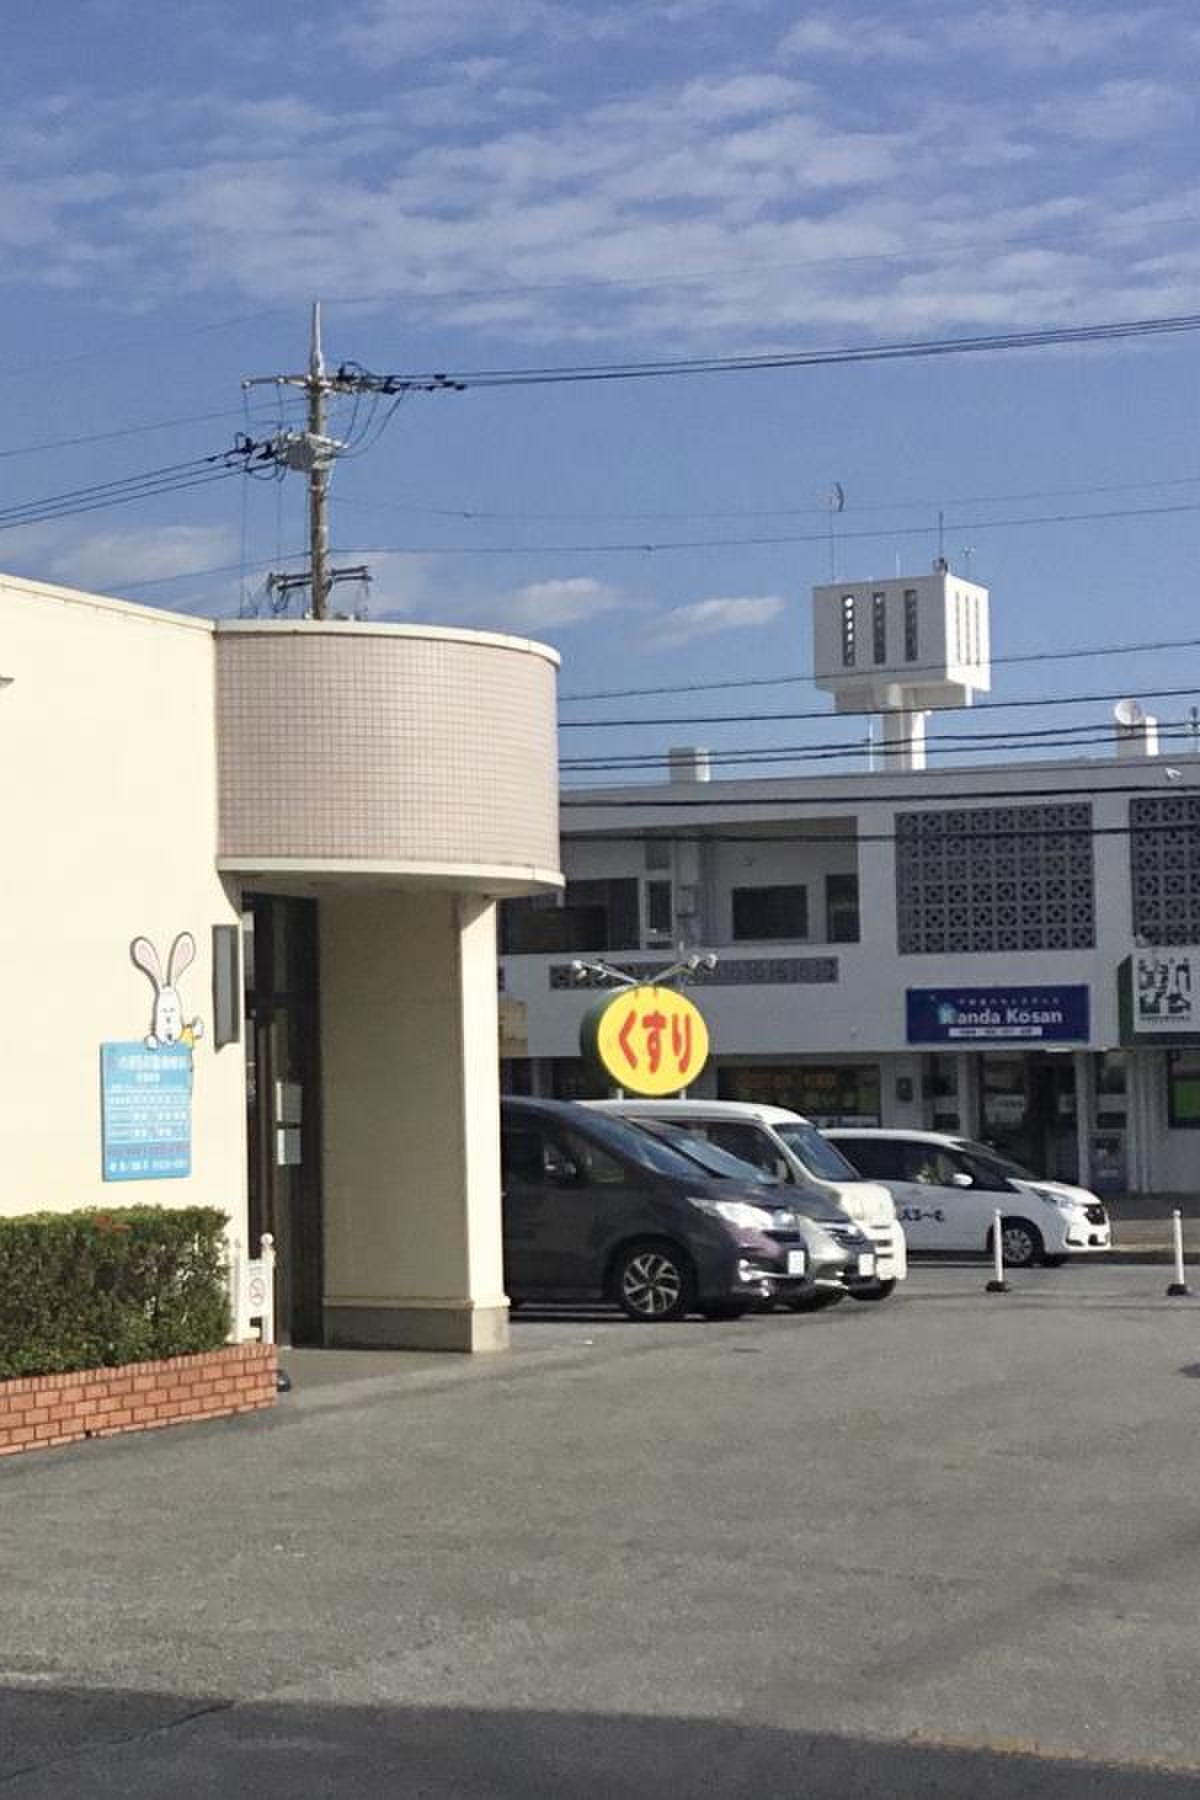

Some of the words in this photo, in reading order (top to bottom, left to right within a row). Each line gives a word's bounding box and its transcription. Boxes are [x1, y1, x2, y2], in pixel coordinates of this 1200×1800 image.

[1006, 1007, 1063, 1024] Kosan
[618, 1010, 692, 1075] くすり
